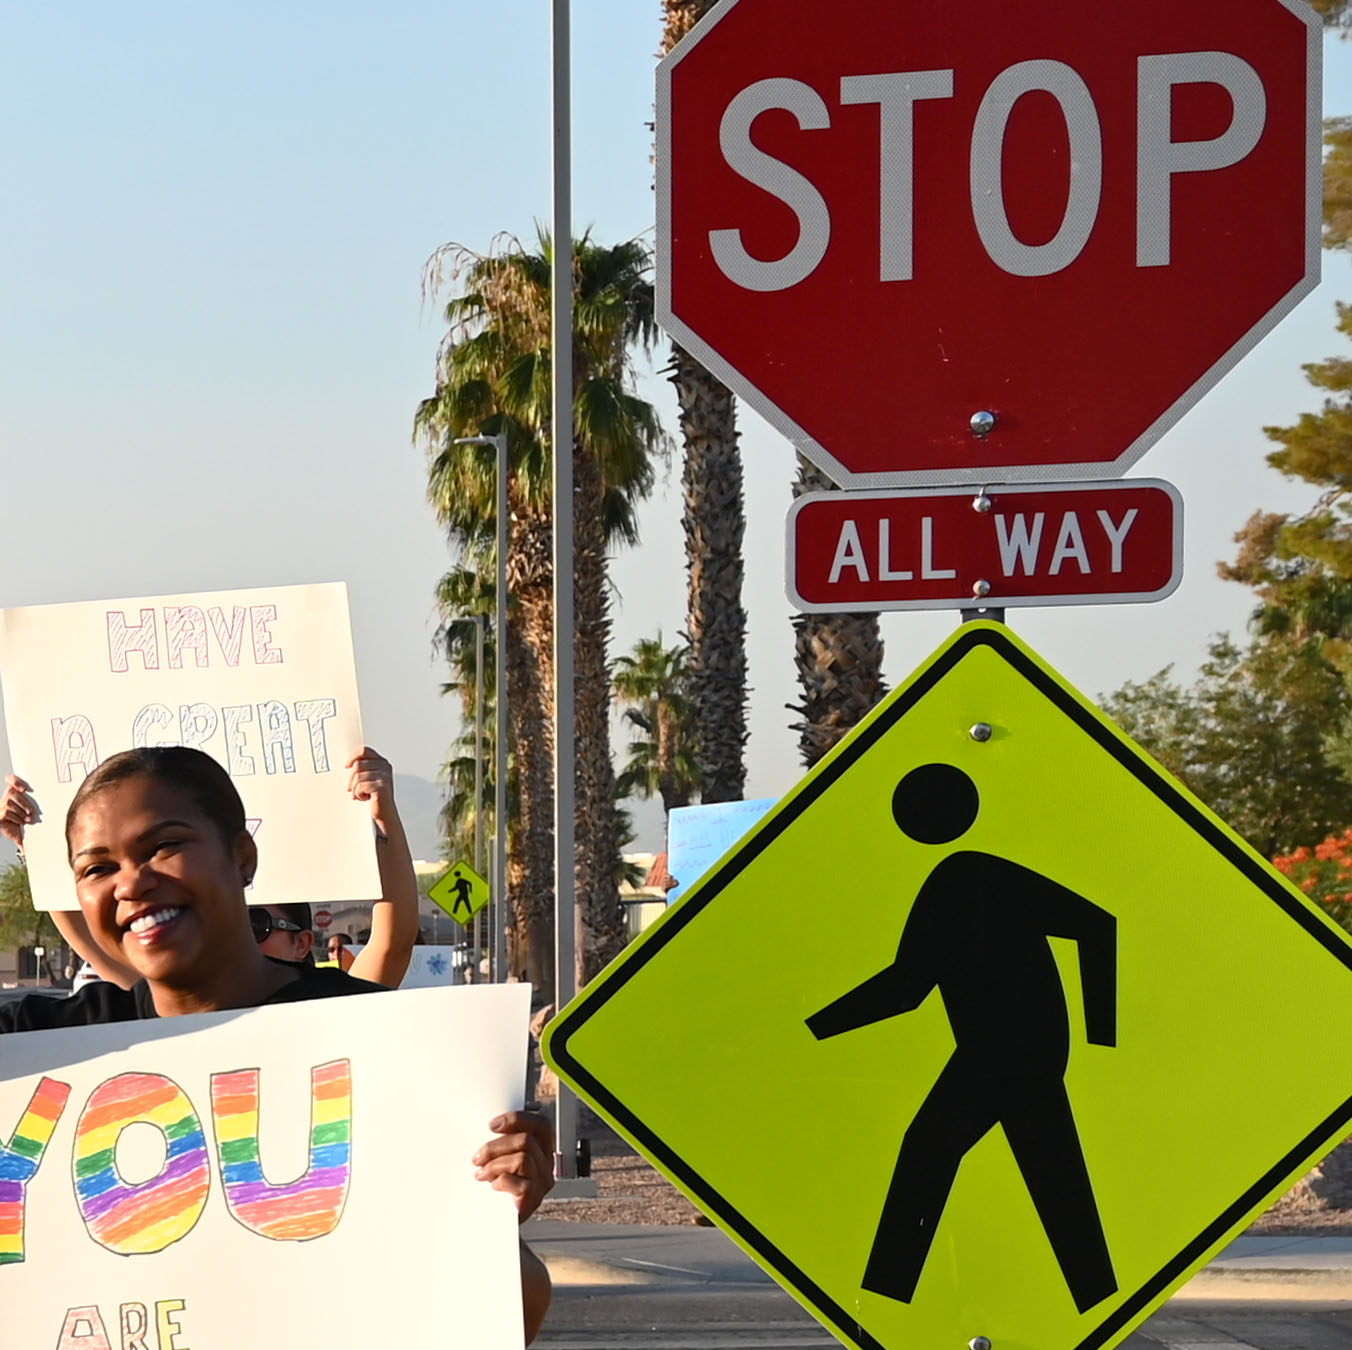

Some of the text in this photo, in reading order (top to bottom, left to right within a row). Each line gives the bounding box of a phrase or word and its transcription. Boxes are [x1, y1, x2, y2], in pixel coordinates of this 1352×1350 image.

[708, 50, 1268, 293] STOP
[828, 509, 1139, 584] ALL WAY
[106, 603, 284, 673] HAVE
[51, 714, 100, 783] A
